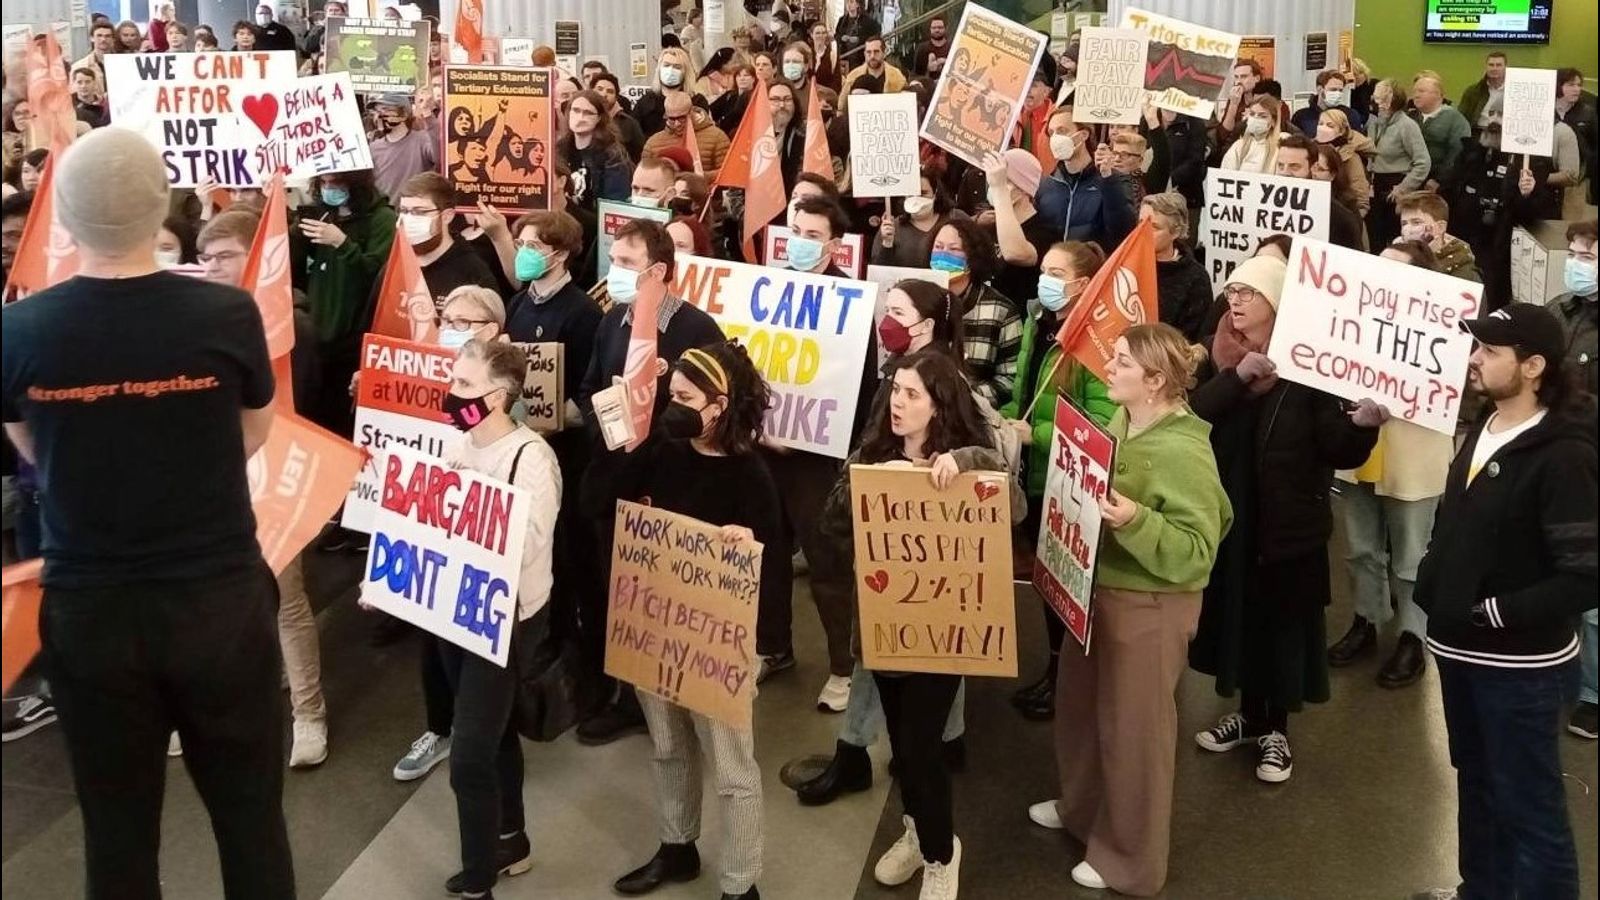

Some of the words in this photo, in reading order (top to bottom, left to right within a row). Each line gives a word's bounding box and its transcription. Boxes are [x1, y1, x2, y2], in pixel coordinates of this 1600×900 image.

[1084, 37, 1141, 63] FAIR
[136, 56, 177, 81] WE
[193, 53, 270, 80] CAN'T
[450, 71, 498, 81] Socialists
[500, 73, 529, 82] Stand
[532, 73, 547, 82] for
[1087, 61, 1135, 86] PAY
[156, 85, 233, 114] AFFOR
[284, 85, 326, 119] BEING
[332, 82, 344, 101] A
[453, 83, 492, 95] Tertiary
[494, 85, 543, 94] Education
[1077, 84, 1140, 109] NOW
[164, 118, 217, 146] NOT
[856, 110, 909, 132] FAIR
[935, 114, 953, 130] Fight
[953, 124, 963, 134] for
[964, 131, 976, 142] our
[296, 138, 326, 165] NEED
[861, 132, 905, 154] PAY
[162, 149, 253, 184] STRIK
[856, 154, 913, 176] NOW
[456, 182, 480, 193] Fight
[483, 184, 497, 193] for
[518, 186, 541, 195] right
[491, 195, 519, 203] learn!
[1217, 178, 1250, 200] IF
[1260, 182, 1310, 211] YOU
[1210, 203, 1244, 224] CAN
[1256, 209, 1314, 234] READ
[1210, 229, 1249, 251] THIS
[667, 262, 731, 314] WE
[750, 276, 864, 334] CAN'T
[1299, 246, 1347, 297] No
[1359, 281, 1398, 321] pay
[1407, 291, 1477, 335] rise?
[1330, 309, 1361, 344] in
[1373, 317, 1448, 375] THIS
[365, 343, 454, 383] FAIRNES
[122, 374, 220, 397] together.
[372, 382, 391, 400] at
[763, 392, 838, 445] RIKE
[381, 454, 514, 556] BARGAIN
[860, 492, 934, 523] MORE
[938, 500, 1006, 525] WORK
[675, 530, 715, 559] WORK
[721, 546, 759, 577] WORK
[866, 531, 927, 563] LESS
[936, 534, 985, 563] PAY
[618, 544, 661, 571] WORK
[671, 559, 713, 588] WORK
[370, 532, 448, 610] DONT
[453, 563, 509, 655] BEG
[1042, 572, 1055, 597] On
[1055, 591, 1076, 626] strike
[675, 604, 749, 665] BETTER
[874, 623, 918, 654] NO
[926, 623, 1005, 662] WAY!
[611, 620, 656, 657] HAVE
[662, 639, 690, 670] MY
[690, 650, 748, 697] MONEY
[657, 662, 684, 702] !!!
